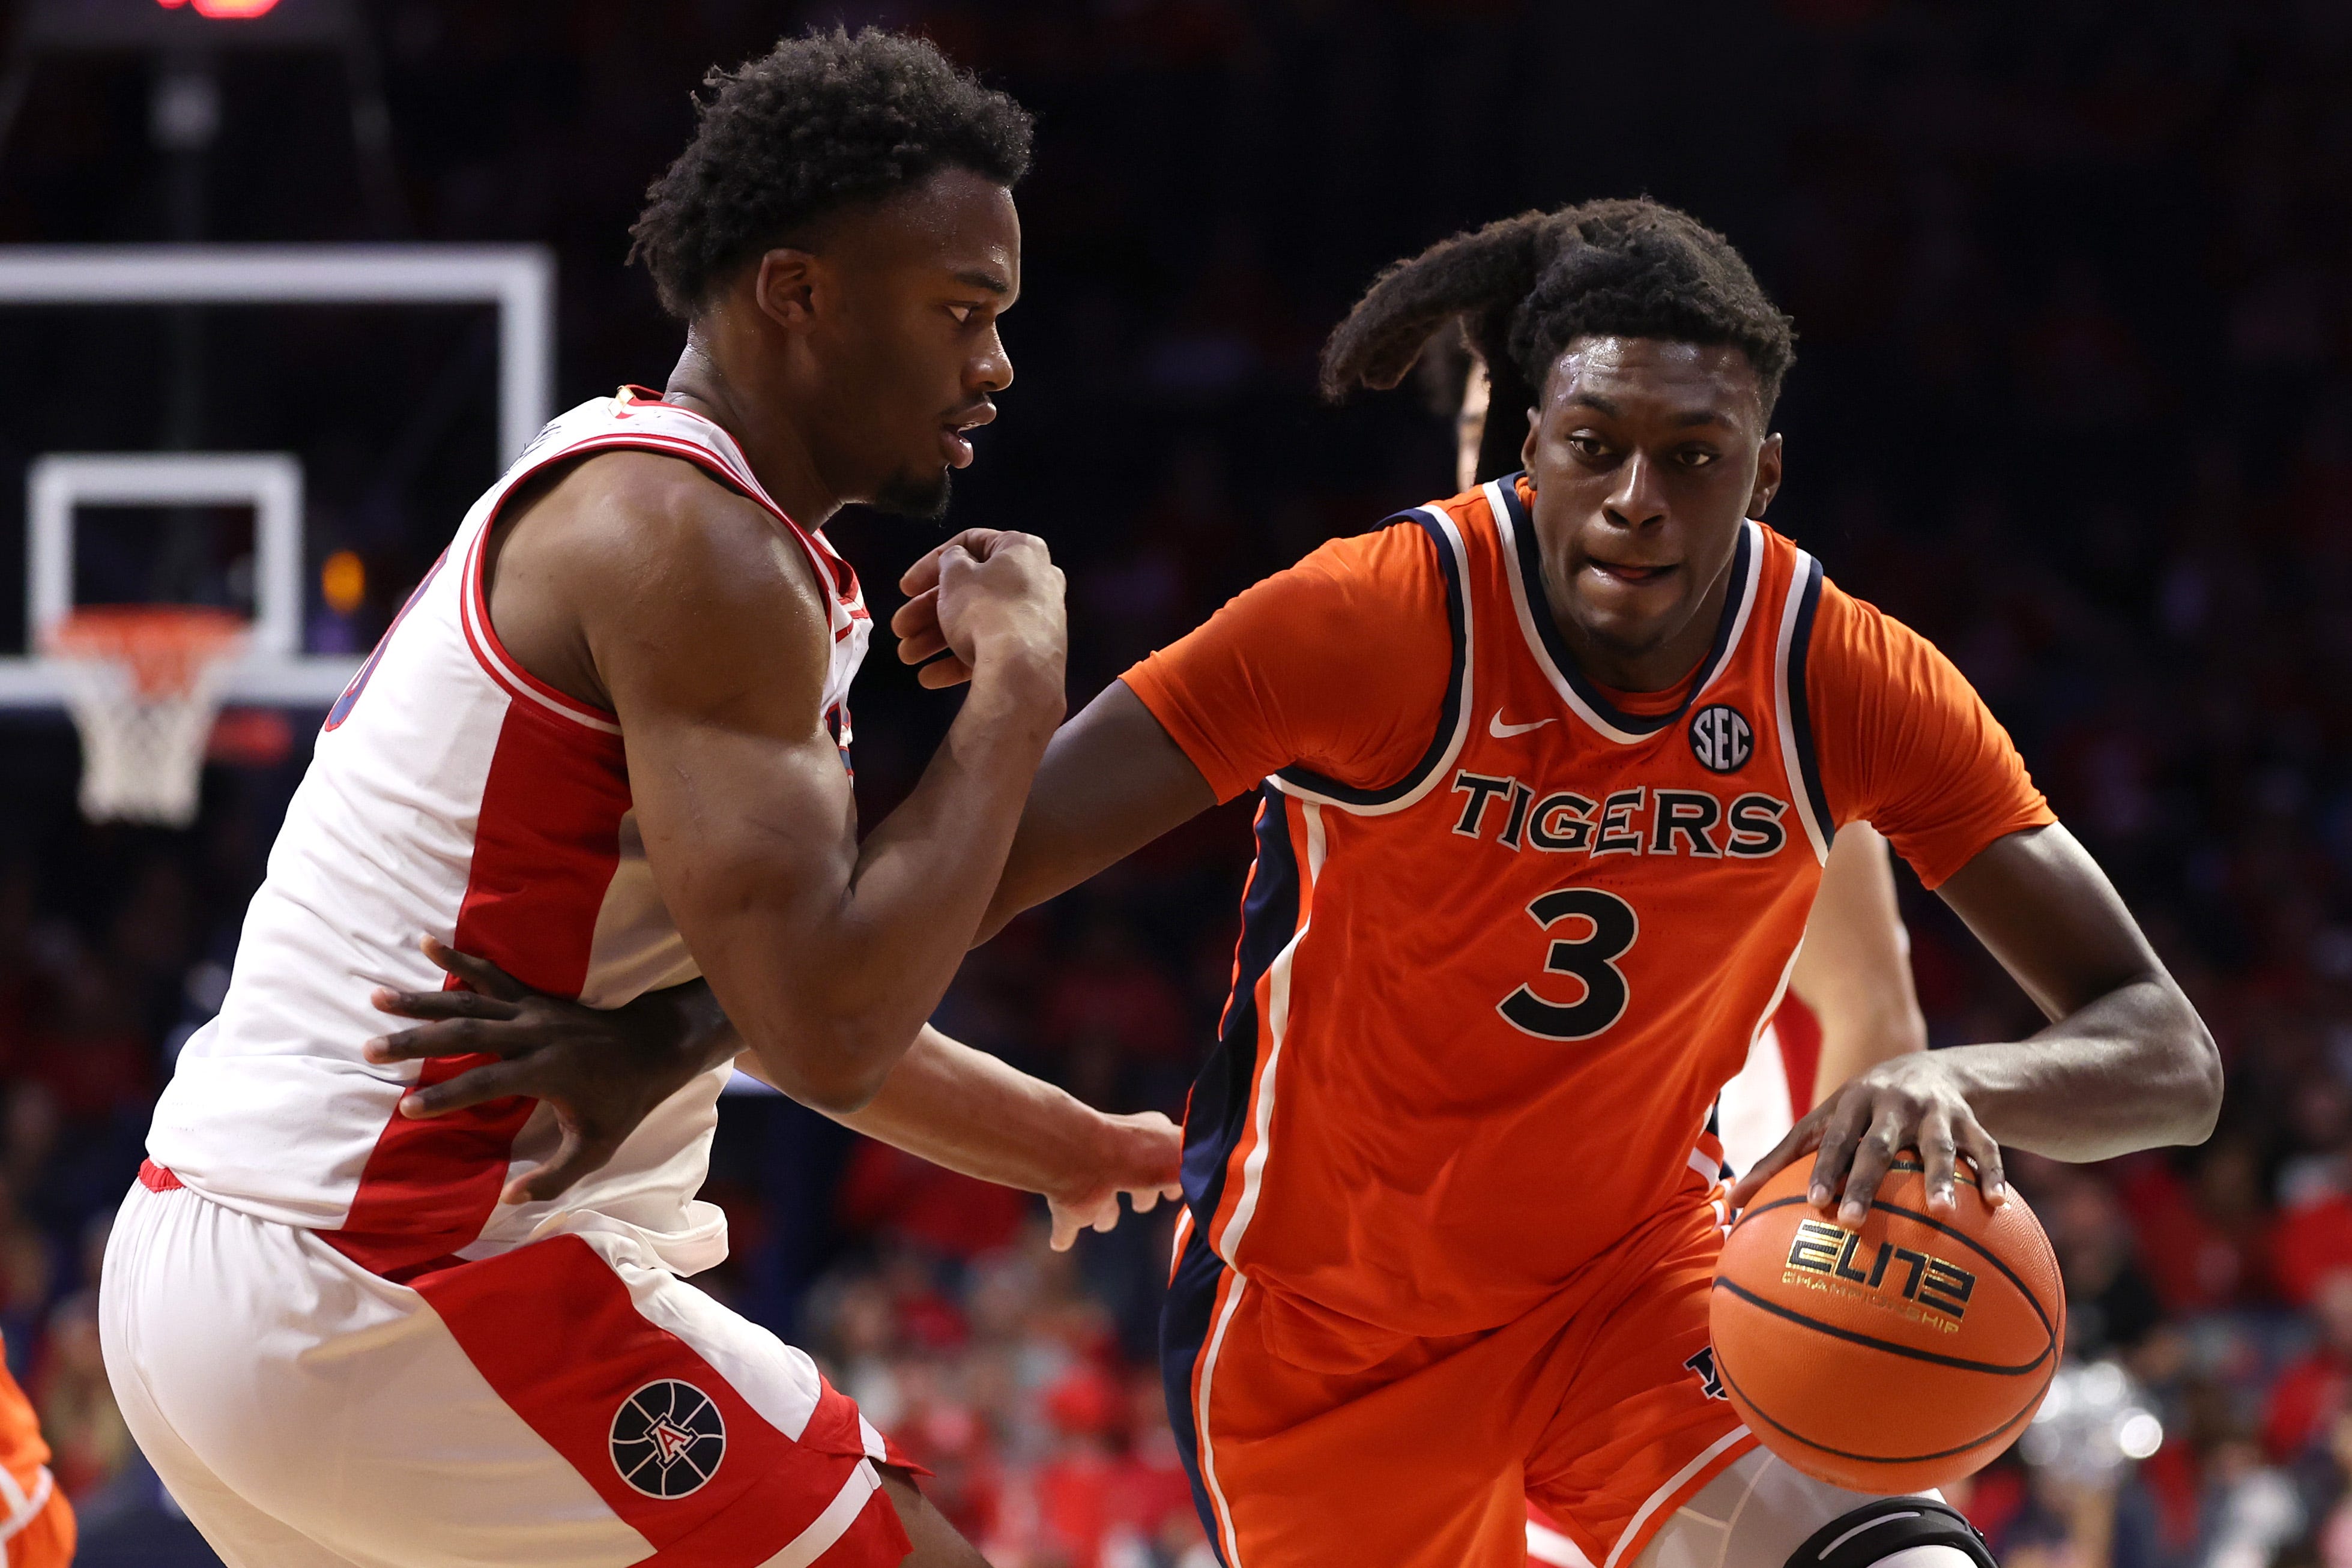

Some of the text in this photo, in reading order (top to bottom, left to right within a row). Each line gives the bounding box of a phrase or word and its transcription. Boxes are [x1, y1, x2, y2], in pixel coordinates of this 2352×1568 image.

[1694, 708, 1750, 770] SEC
[1451, 768, 1790, 860] TIGERS
[1495, 887, 1640, 1042] 3
[1782, 1270, 1959, 1334] CHAMPIONSHIP
[1785, 1219, 1977, 1323] ELITE
[643, 1413, 700, 1470] A
